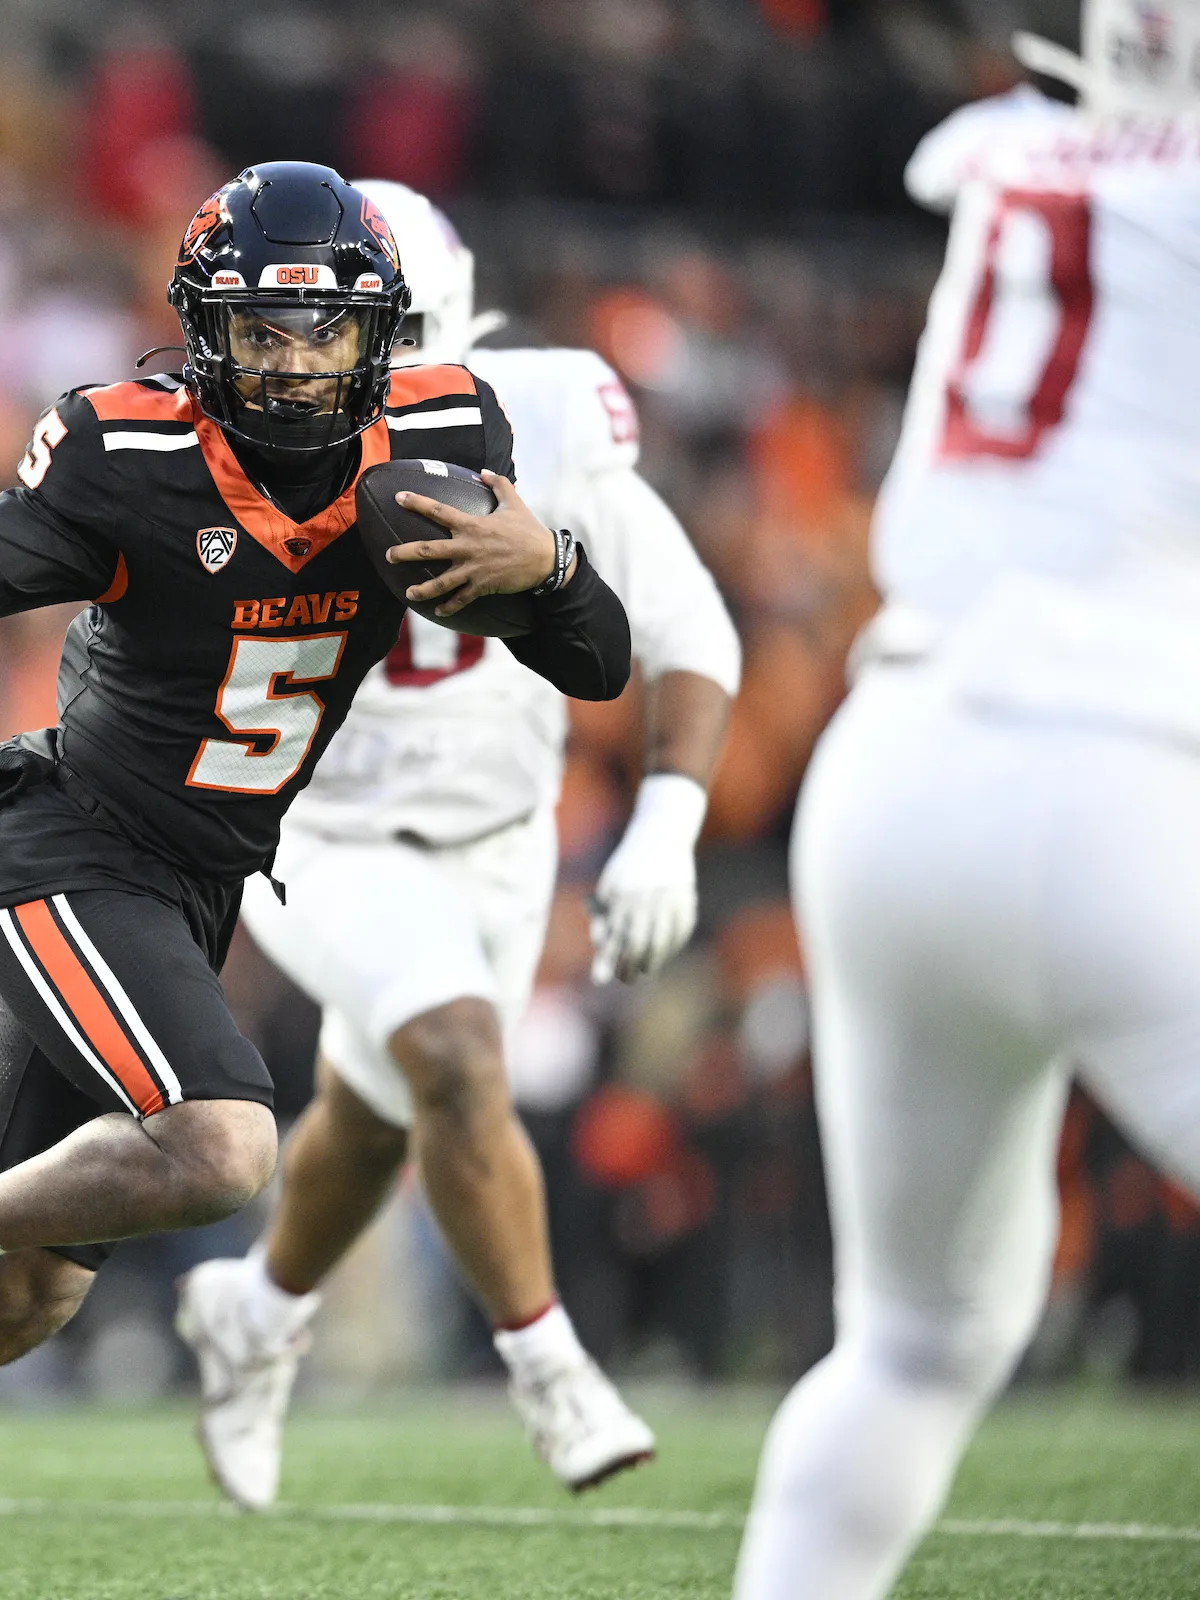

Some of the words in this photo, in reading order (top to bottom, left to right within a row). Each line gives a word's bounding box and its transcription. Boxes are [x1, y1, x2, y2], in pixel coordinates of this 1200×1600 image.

[215, 276, 240, 285] BEAVS
[276, 267, 319, 285] OSU
[17, 407, 69, 490] 5
[200, 530, 234, 555] PAC
[205, 548, 225, 564] 12
[231, 590, 360, 629] BEAVS
[185, 630, 349, 795] 5
